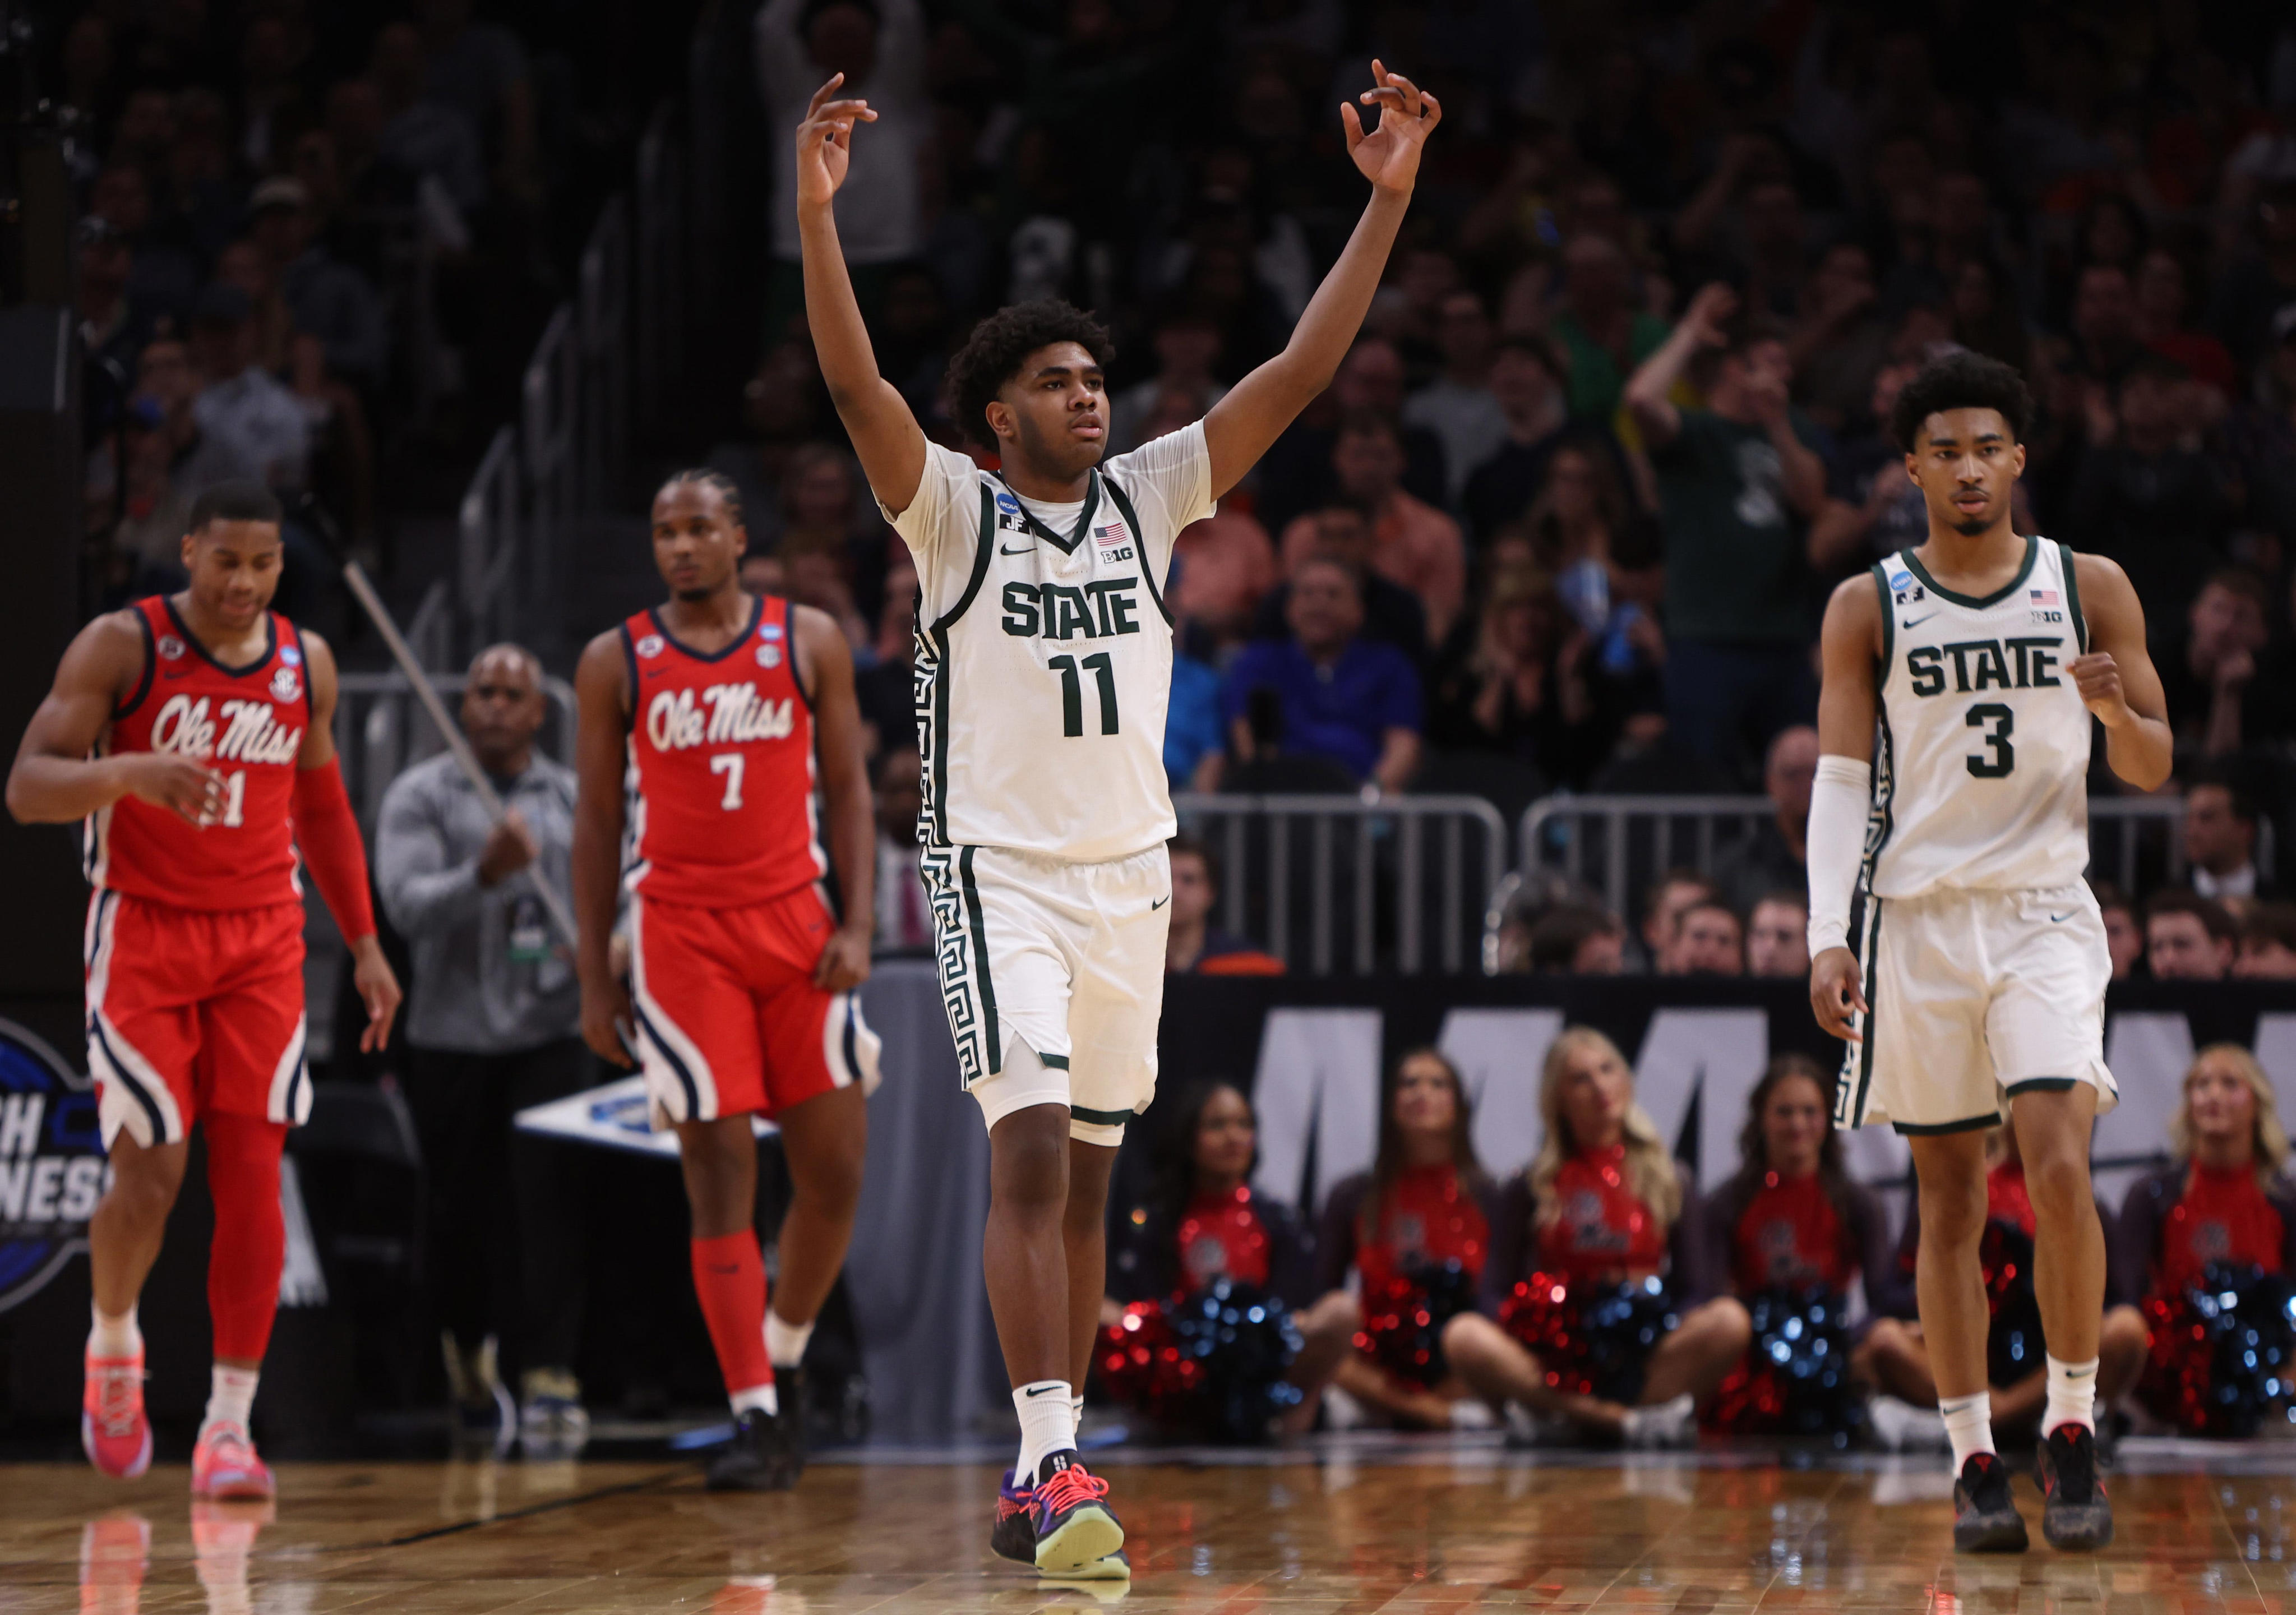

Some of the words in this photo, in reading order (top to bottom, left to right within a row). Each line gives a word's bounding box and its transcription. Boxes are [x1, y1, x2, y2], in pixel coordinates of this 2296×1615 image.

[1000, 500, 1019, 511] NCAA
[1006, 515, 1024, 532] JF
[1002, 577, 1140, 640] STATE
[1048, 652, 1119, 737] 11
[1907, 637, 2064, 698] STATE
[150, 693, 216, 760] Ole
[216, 699, 303, 765] Miss
[647, 687, 705, 753] Ole
[702, 681, 793, 744] Miss
[1966, 703, 2014, 778] 3
[710, 752, 745, 810] 7
[0, 1156, 116, 1222] NES
